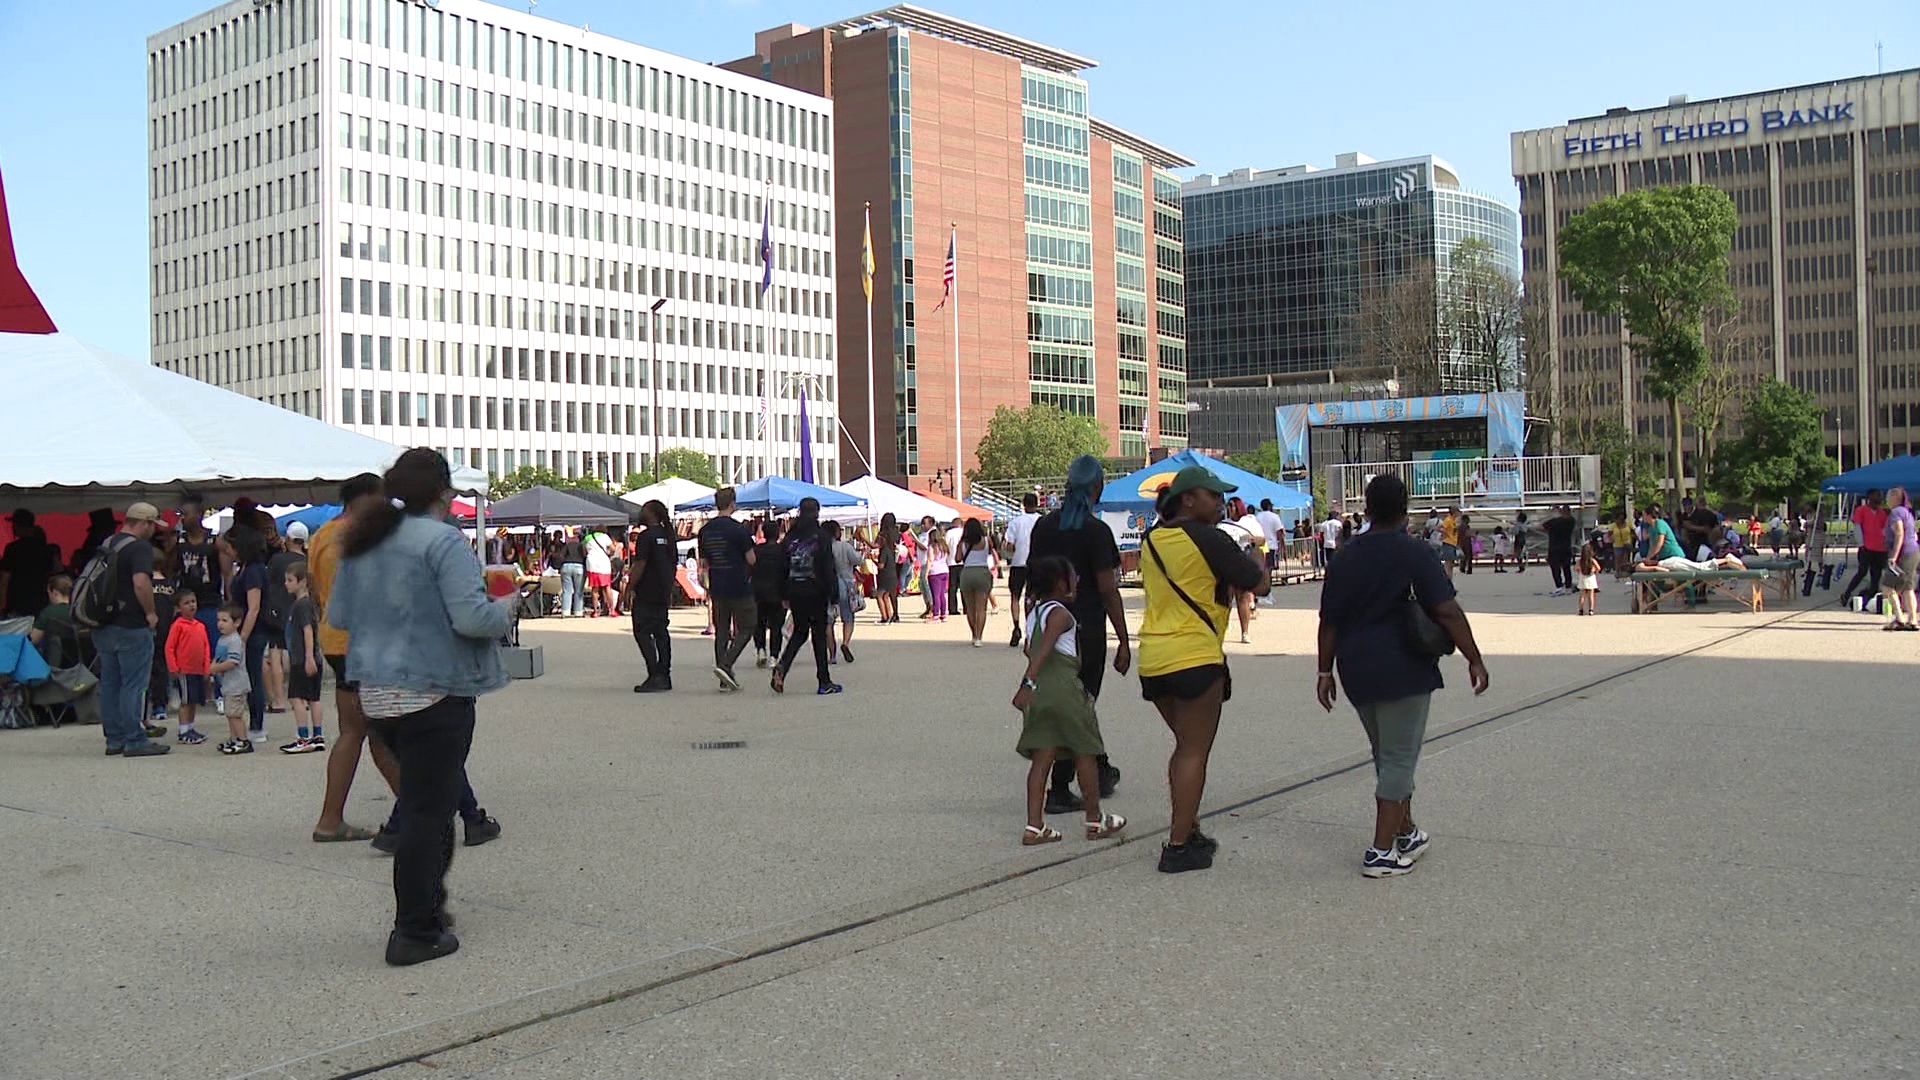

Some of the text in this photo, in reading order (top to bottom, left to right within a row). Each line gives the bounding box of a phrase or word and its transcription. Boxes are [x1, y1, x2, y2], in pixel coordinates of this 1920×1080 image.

[1563, 102, 1856, 158] FIFTH THIRD BANK
[1355, 195, 1392, 207] Warner
[1418, 477, 1428, 485] DJ
[1430, 476, 1461, 484] RODNE
